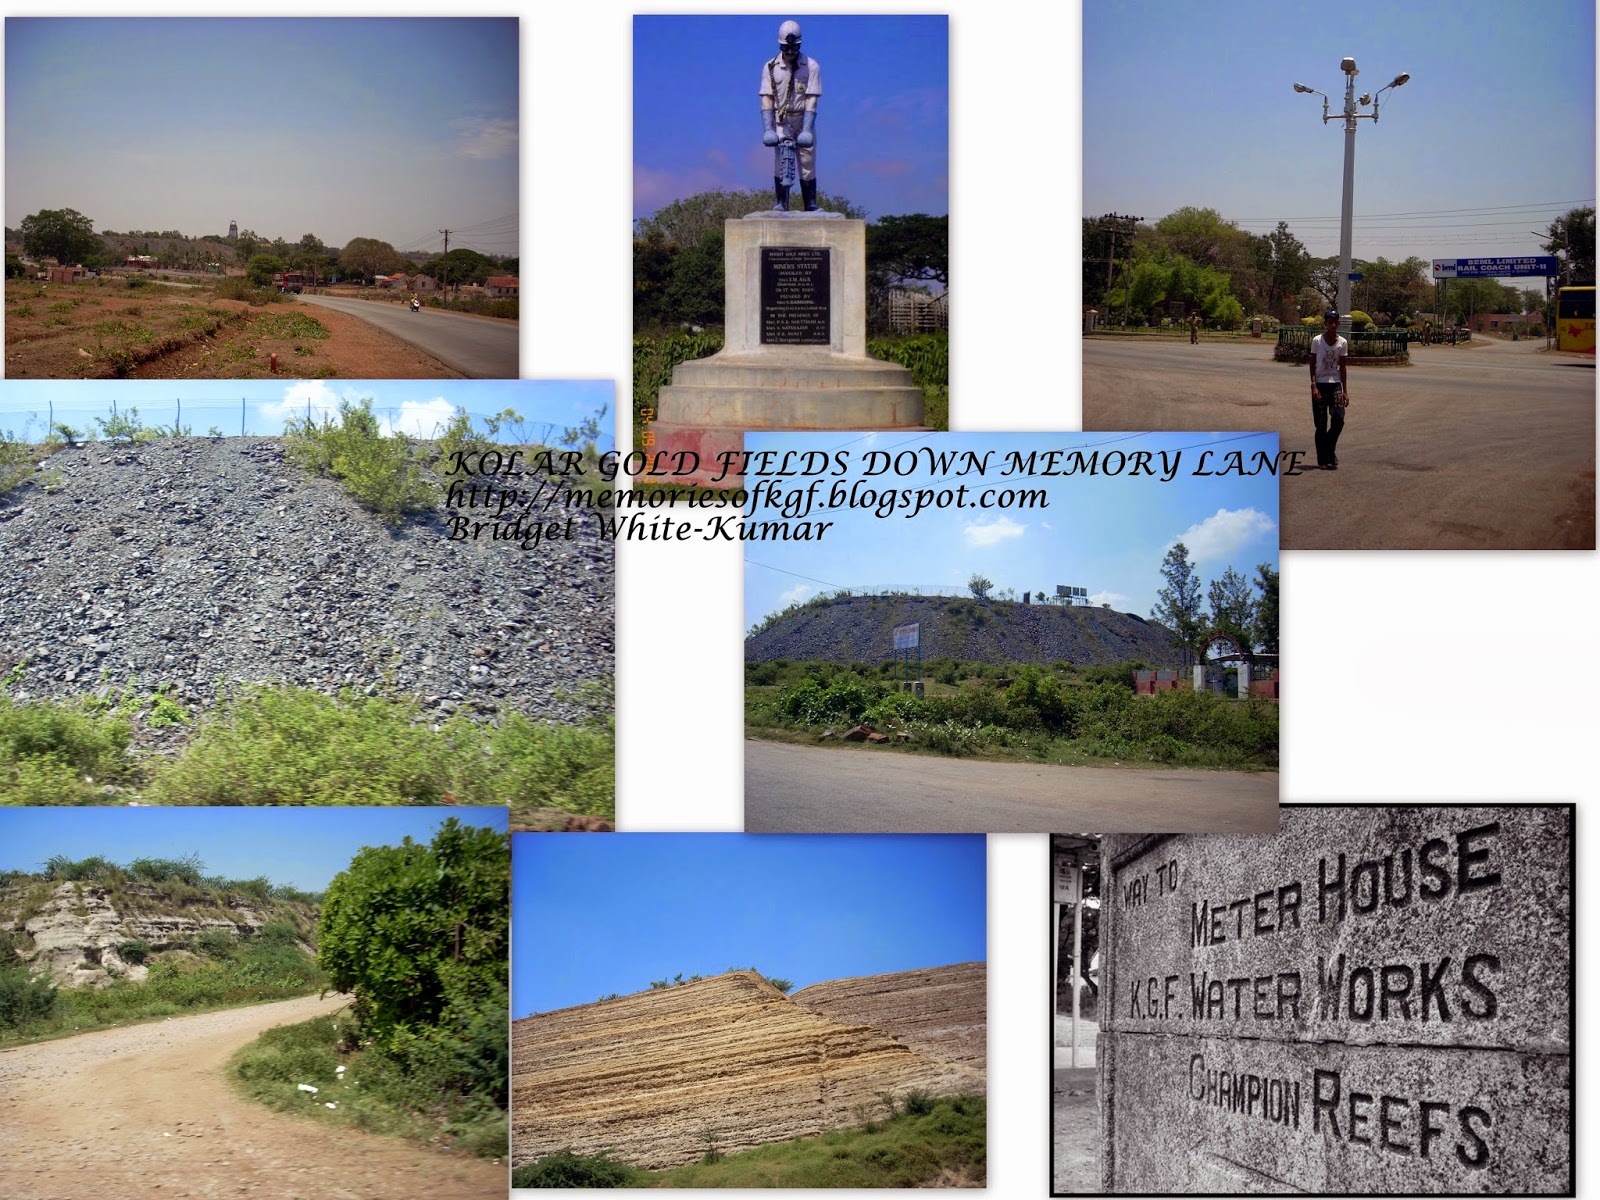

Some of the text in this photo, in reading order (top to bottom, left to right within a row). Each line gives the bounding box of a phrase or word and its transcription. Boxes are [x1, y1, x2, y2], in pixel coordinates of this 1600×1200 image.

[1496, 257, 1537, 265] LIMITED
[1123, 858, 1178, 911] WAY TO
[1191, 823, 1501, 947] METER HOUSE
[1130, 953, 1501, 1023] K.G.F. WATER WORKS
[1188, 1054, 1493, 1170] CHAMPION REEFS
